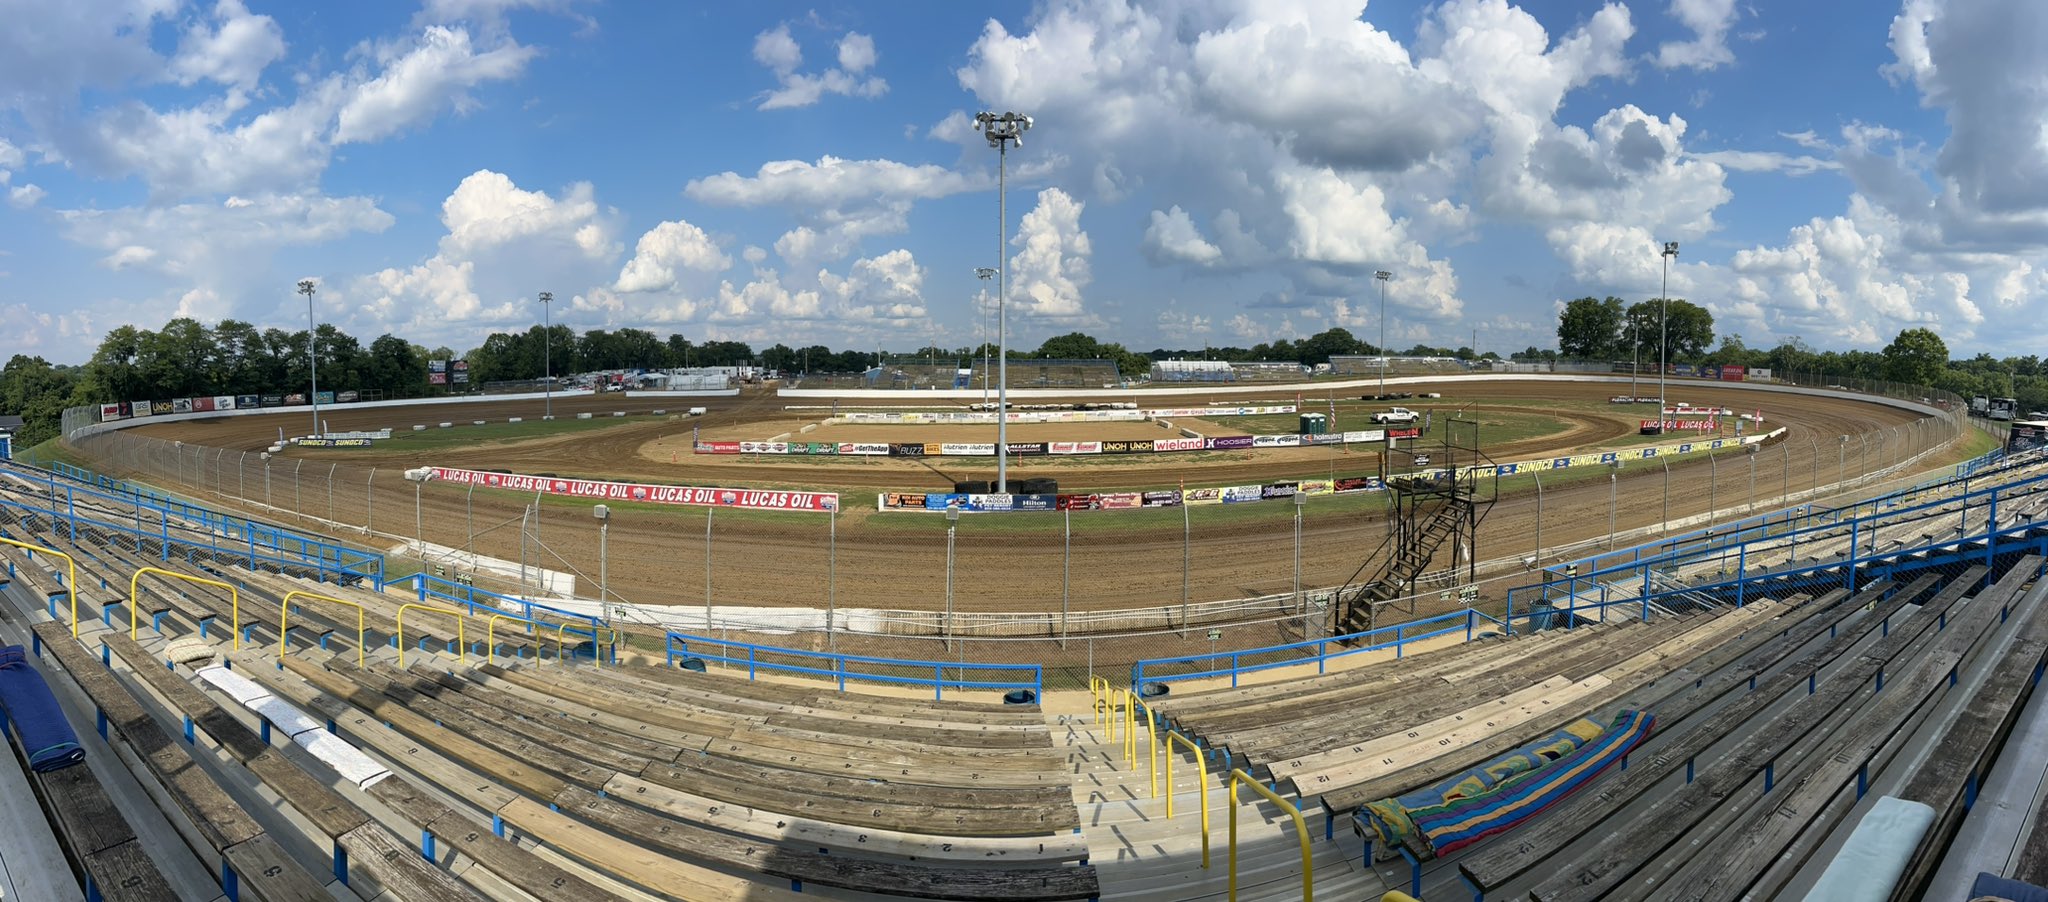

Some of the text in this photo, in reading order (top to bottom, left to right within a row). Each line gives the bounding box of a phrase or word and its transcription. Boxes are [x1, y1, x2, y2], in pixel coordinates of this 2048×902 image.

[153, 402, 173, 412] UNOH
[1680, 421, 1702, 429] LUCAS
[1104, 442, 1127, 450] UNOH
[1130, 442, 1152, 450] UNOH
[1156, 439, 1202, 450] wieland
[1690, 442, 1712, 452] SUNOCO
[900, 447, 923, 455] BUZZ
[1654, 445, 1680, 456] SUNOCO
[1568, 454, 1602, 466] SUNOCO
[1616, 451, 1644, 462] SUNOCO
[1516, 460, 1554, 474] SUNOCO
[444, 470, 486, 484] LUCAS OIL
[1456, 468, 1498, 480] SUNOCO
[502, 477, 551, 491] LUCAS OIL
[571, 482, 628, 498] LUCAS OIL
[651, 488, 716, 503] LUCAS OIL
[741, 491, 814, 508] LUCAS OIL
[1438, 738, 1450, 746] 10
[1317, 775, 1330, 783] 12
[858, 834, 868, 842] 3
[943, 844, 952, 852] 2
[550, 877, 566, 888] 5
